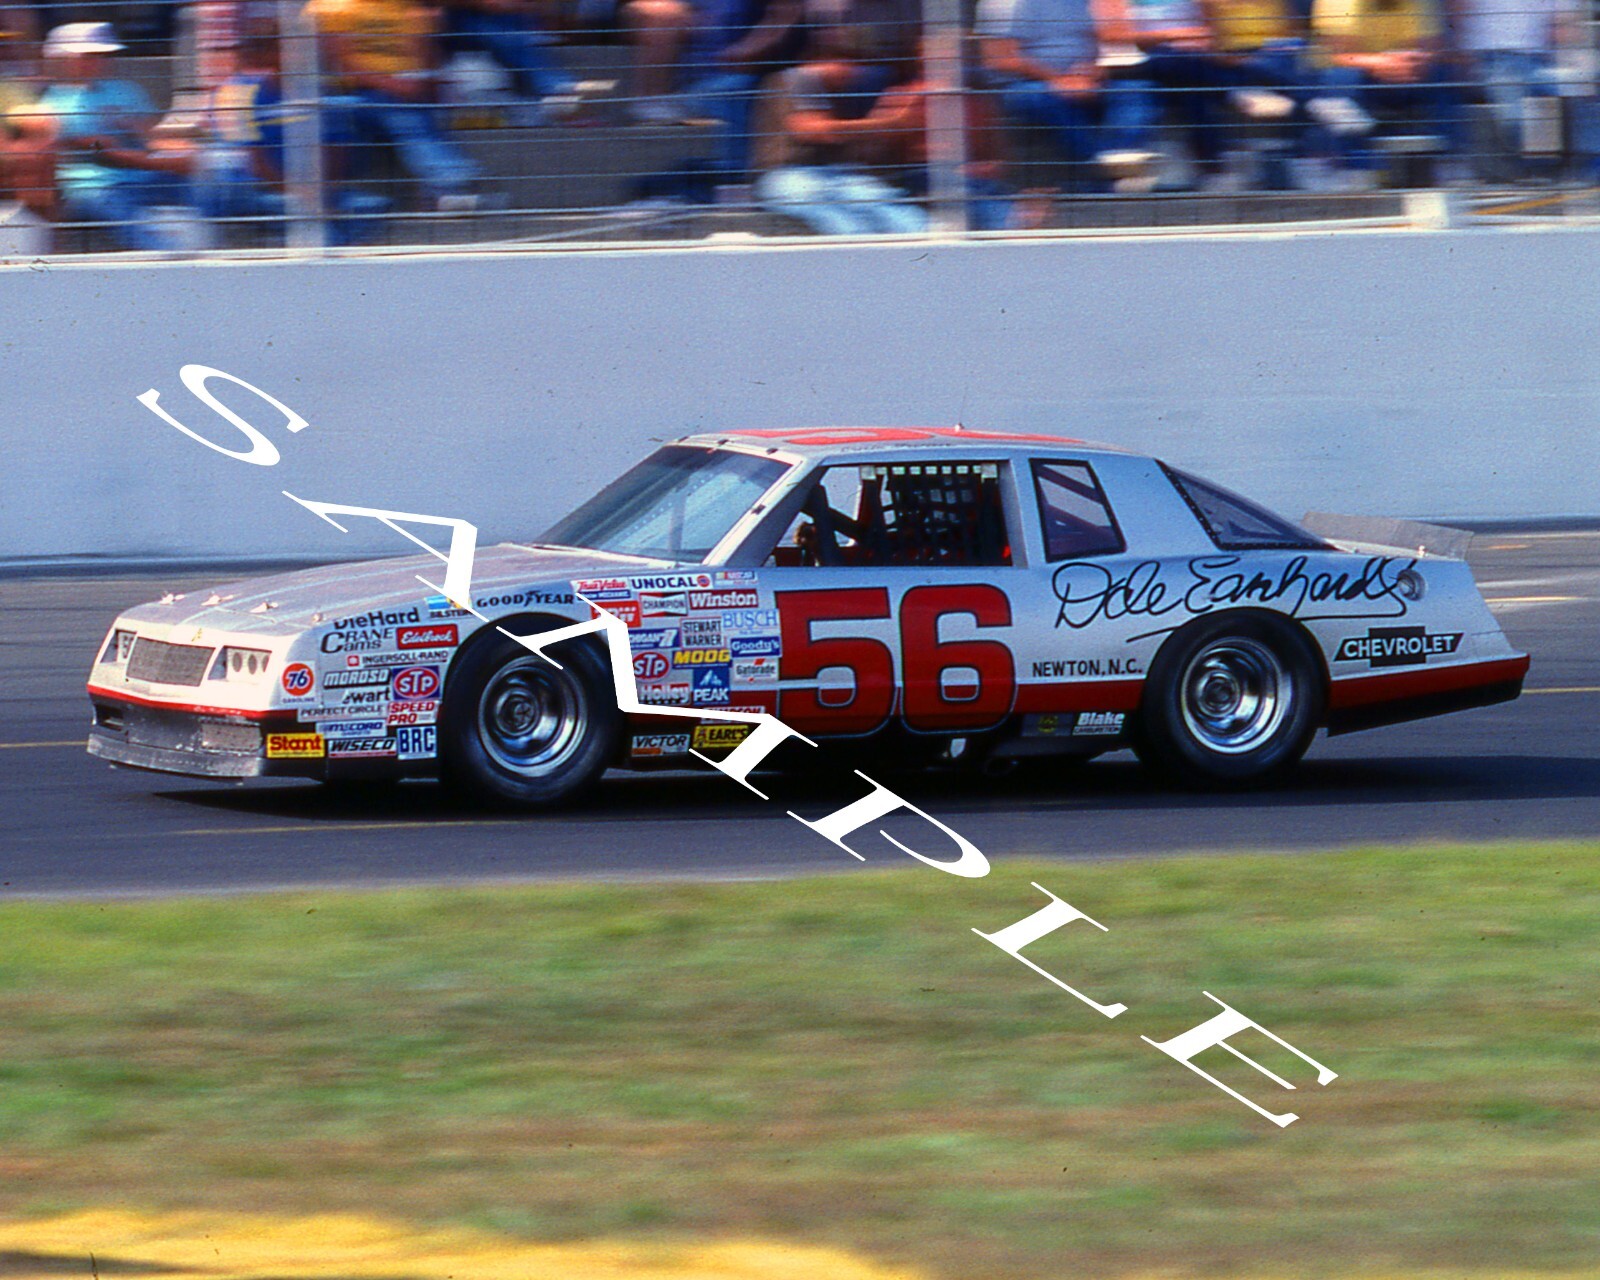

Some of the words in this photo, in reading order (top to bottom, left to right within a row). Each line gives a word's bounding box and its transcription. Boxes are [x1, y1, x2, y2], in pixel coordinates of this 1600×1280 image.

[631, 576, 697, 590] UNOCAL
[476, 590, 574, 608] GOODYEAR
[690, 591, 757, 608] Winston
[1052, 560, 1183, 629] Dale
[643, 600, 685, 609] CHAMPION
[722, 609, 778, 628] BUSCH
[682, 620, 722, 634] STEWART
[684, 633, 722, 647] WARNER
[1343, 634, 1454, 658] CHEVROLET
[633, 653, 666, 676] STP
[673, 649, 731, 664] MOOG
[774, 582, 1018, 739] 56
[736, 664, 776, 675] Gatorade
[1107, 659, 1143, 675] N.C.
[287, 670, 309, 689] 76
[323, 669, 389, 688] MOROSO
[400, 671, 434, 693] STP
[640, 684, 690, 703] Holley
[694, 688, 729, 701] PEAK
[390, 702, 435, 713] SPEED
[388, 713, 418, 724] PRO
[1078, 712, 1125, 725] Blake
[270, 735, 321, 751] Stant
[330, 739, 395, 751] WISECO
[400, 727, 435, 753] BRC
[635, 735, 688, 747] VICTOR
